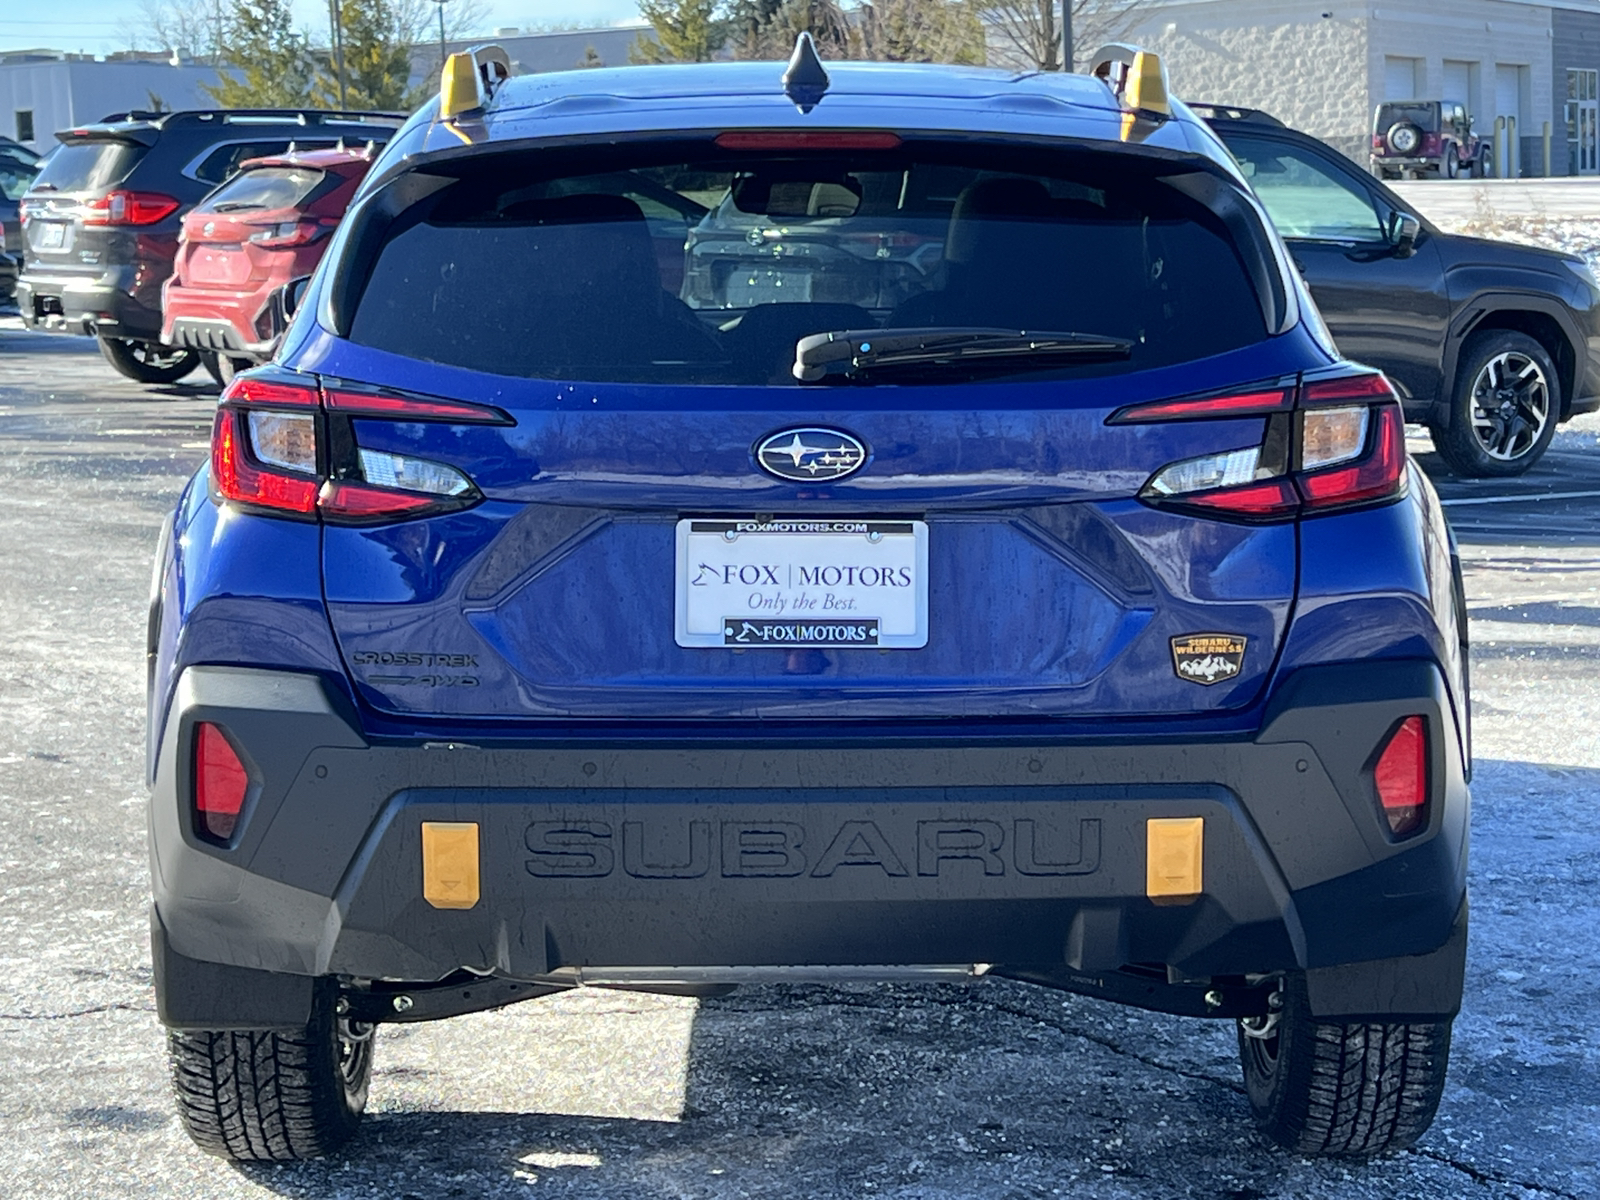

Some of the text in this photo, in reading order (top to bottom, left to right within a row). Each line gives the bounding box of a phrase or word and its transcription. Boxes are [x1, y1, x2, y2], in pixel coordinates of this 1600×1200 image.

[736, 522, 868, 533] FOXMOTORS.COM
[722, 564, 912, 588] FOX MOTORS
[748, 592, 859, 615] Only the Best.
[353, 651, 480, 668] CROSSTREK
[413, 674, 480, 687] AWD
[524, 818, 1103, 879] SUBARU
